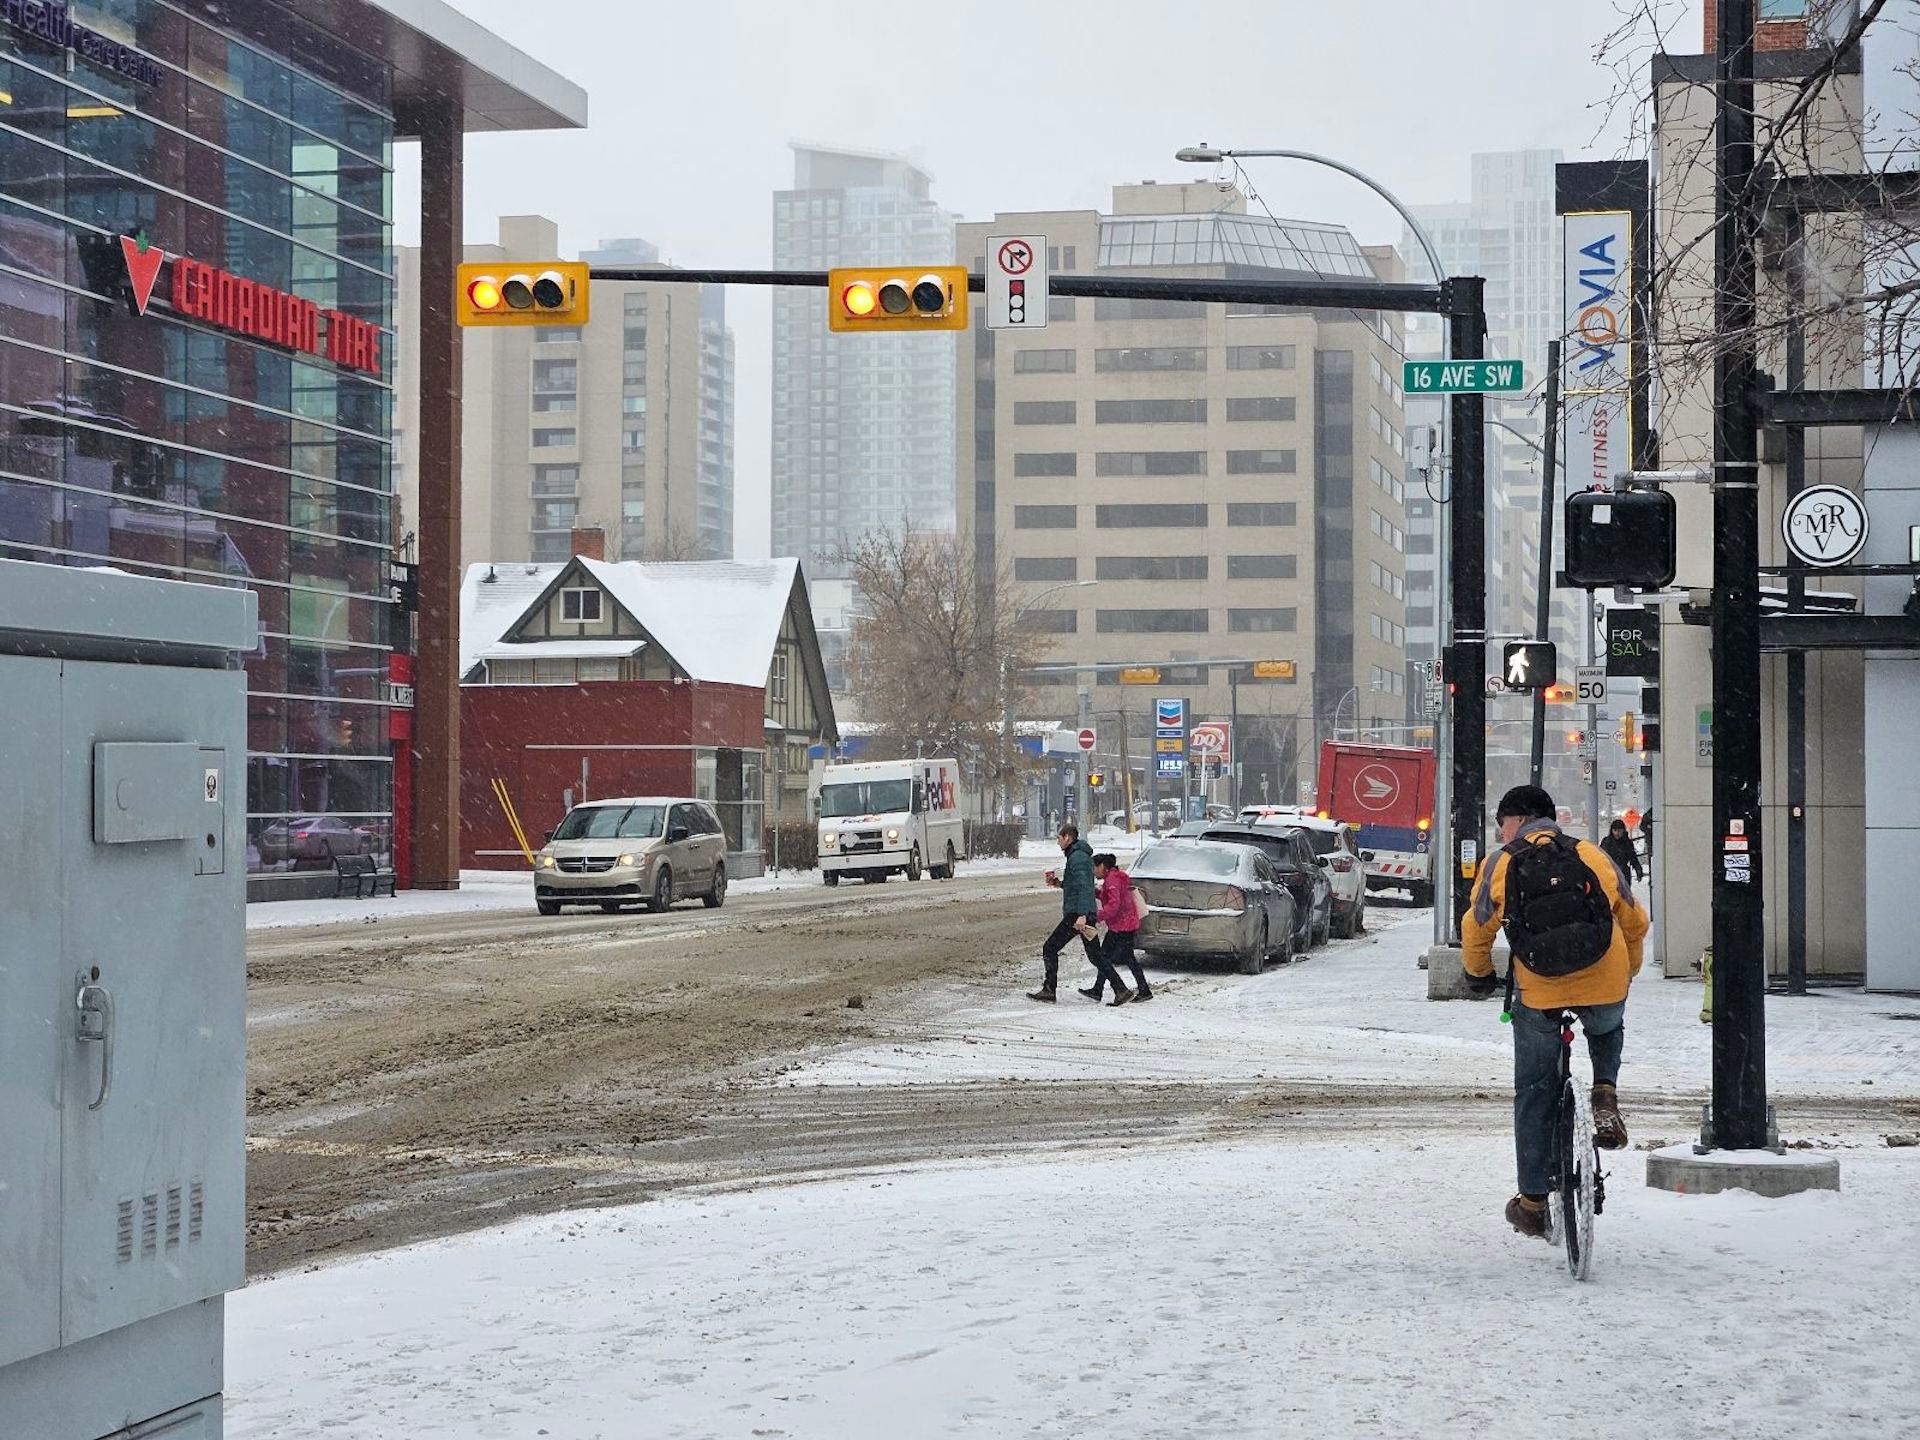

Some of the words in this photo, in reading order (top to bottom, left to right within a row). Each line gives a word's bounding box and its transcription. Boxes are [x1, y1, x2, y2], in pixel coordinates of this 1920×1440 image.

[1578, 233, 1616, 371] VOVIA
[172, 256, 319, 354] CANADIAN
[325, 308, 380, 375] TIRE
[1413, 366, 1432, 388] 16
[1440, 366, 1476, 388] AVE
[1484, 364, 1513, 387] SW
[1593, 407, 1608, 478] FITNESS
[1611, 629, 1643, 641] FOR
[1578, 681, 1605, 699] 50
[1192, 733, 1217, 748] DQ
